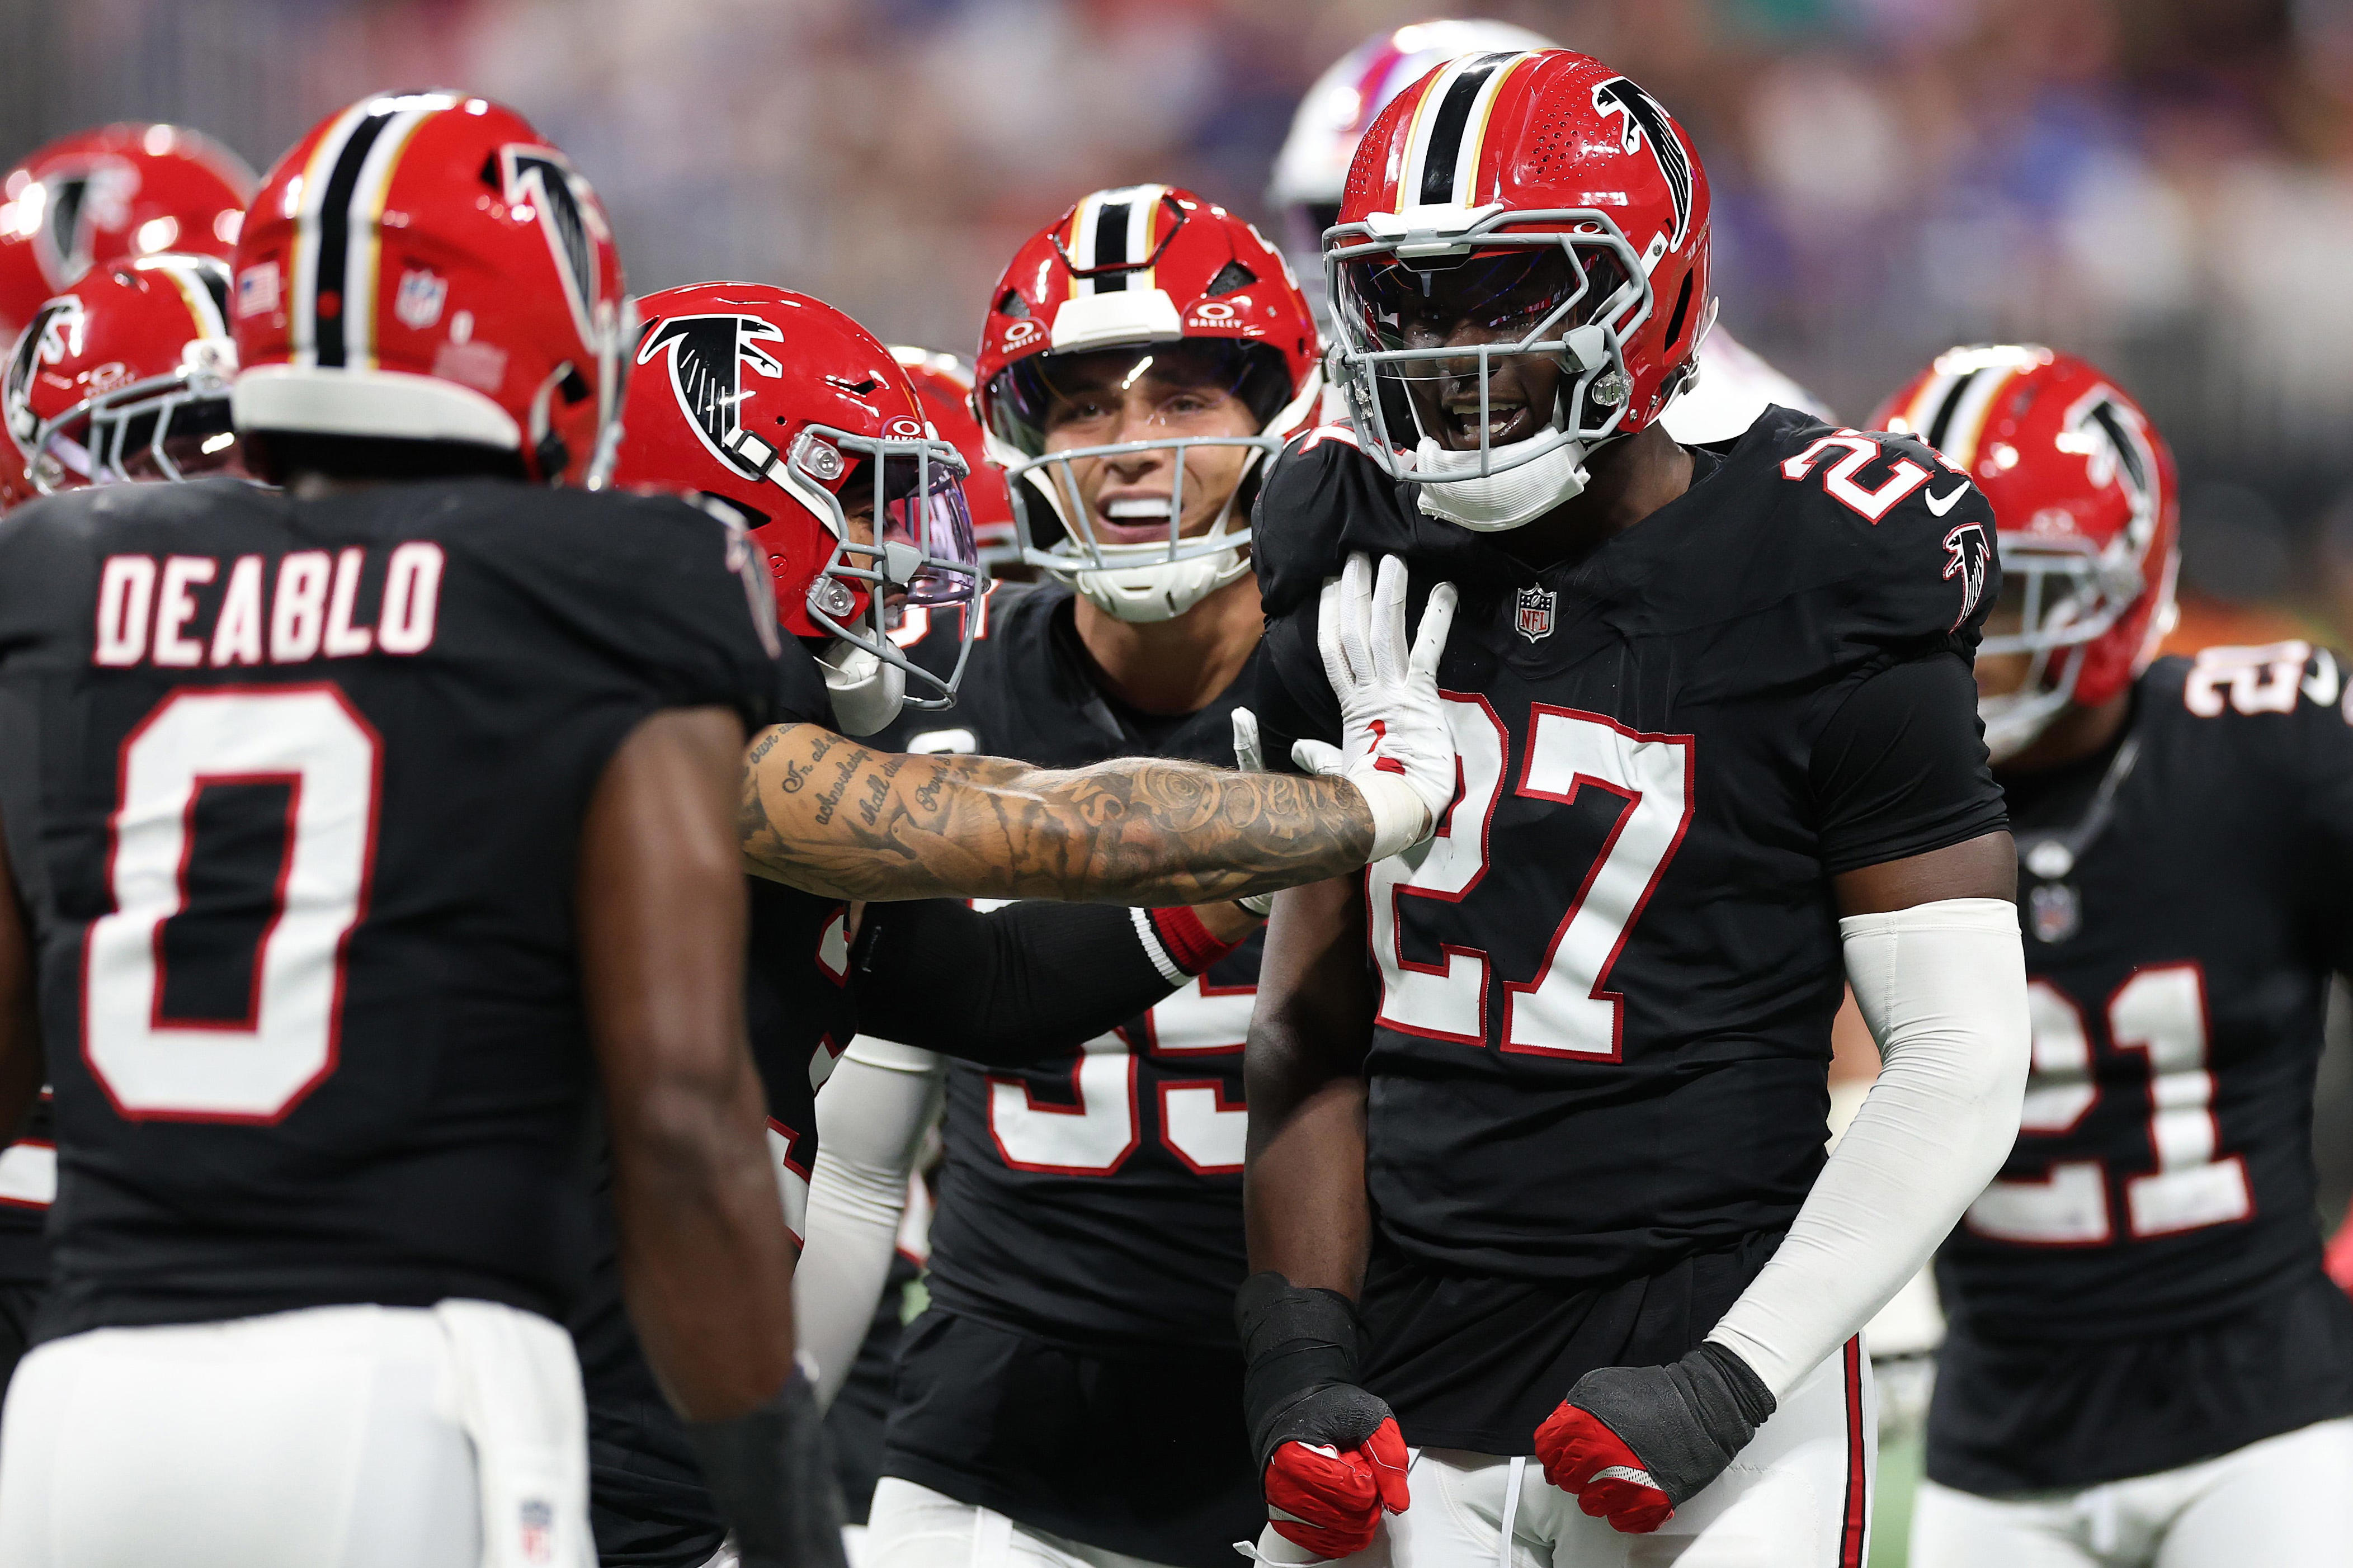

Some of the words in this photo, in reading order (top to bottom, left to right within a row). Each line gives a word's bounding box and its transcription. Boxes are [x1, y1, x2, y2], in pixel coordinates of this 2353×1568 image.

[91, 539, 447, 669] DEABLO
[1520, 609, 1548, 632] NFL
[78, 680, 386, 1126] 0
[1365, 688, 1695, 1064] 27
[1964, 958, 2257, 1248] 21
